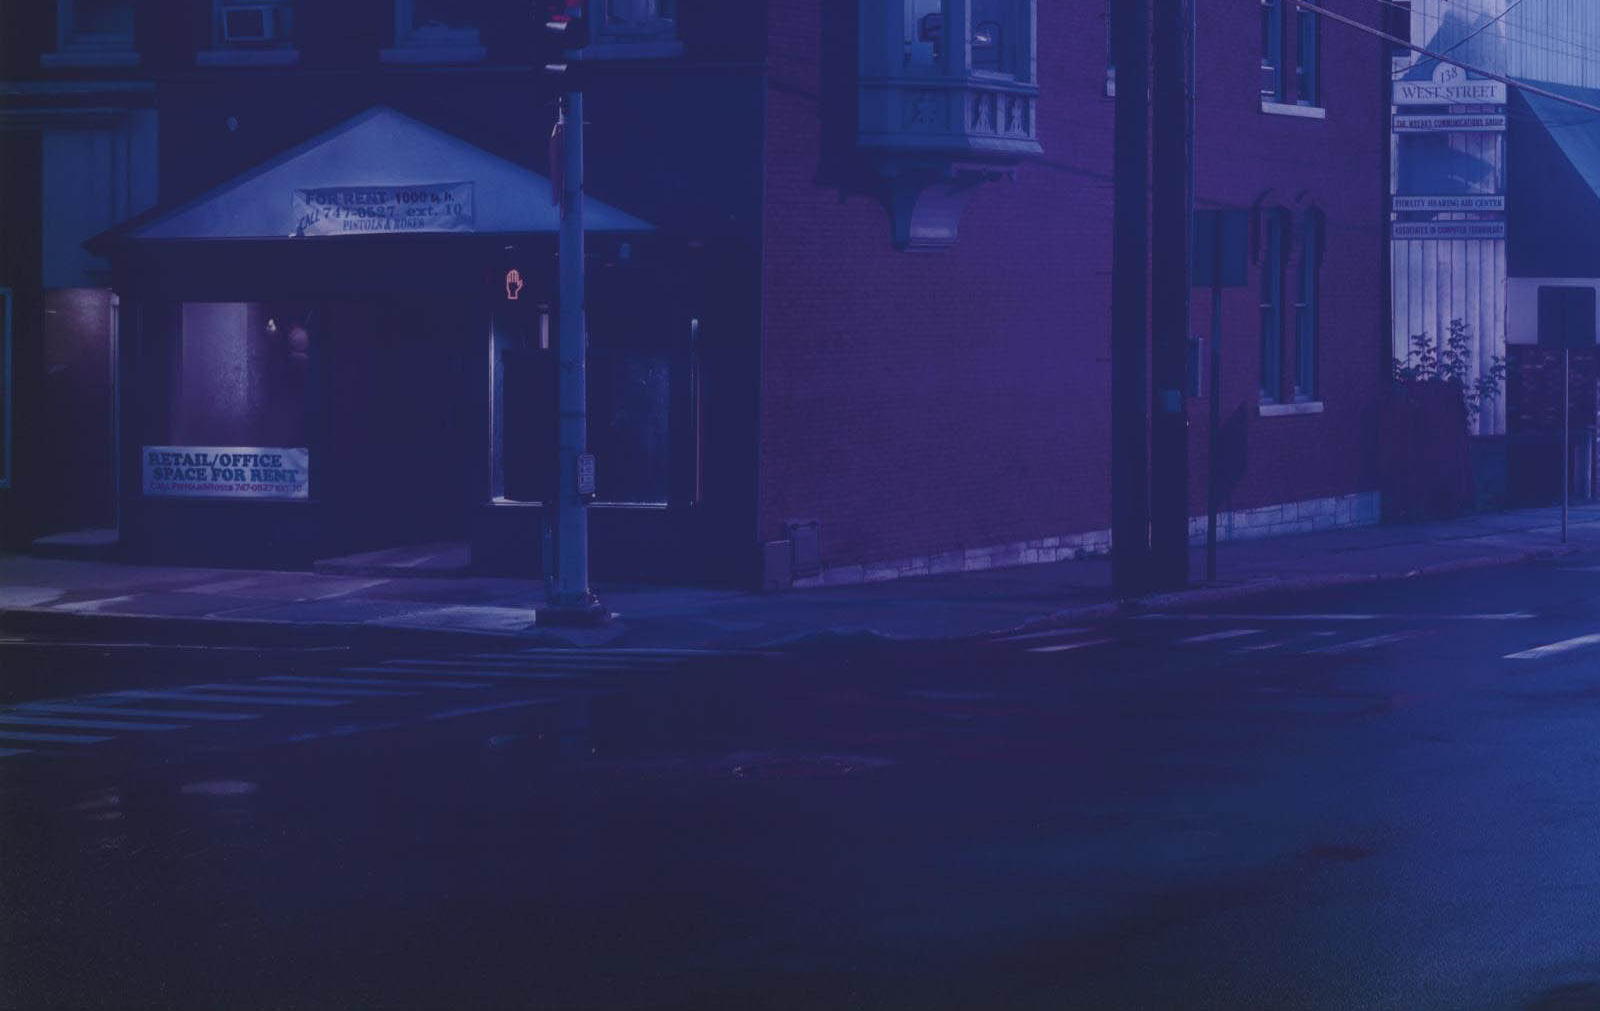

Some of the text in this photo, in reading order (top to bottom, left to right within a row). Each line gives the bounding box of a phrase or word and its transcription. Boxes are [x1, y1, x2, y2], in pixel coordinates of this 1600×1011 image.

[1441, 67, 1458, 84] 138
[1402, 85, 1498, 99] WEST STREET
[344, 190, 388, 205] RENT
[148, 452, 283, 469] RETAIL/OFFICE
[153, 468, 299, 483] SPACE FOR RENT
